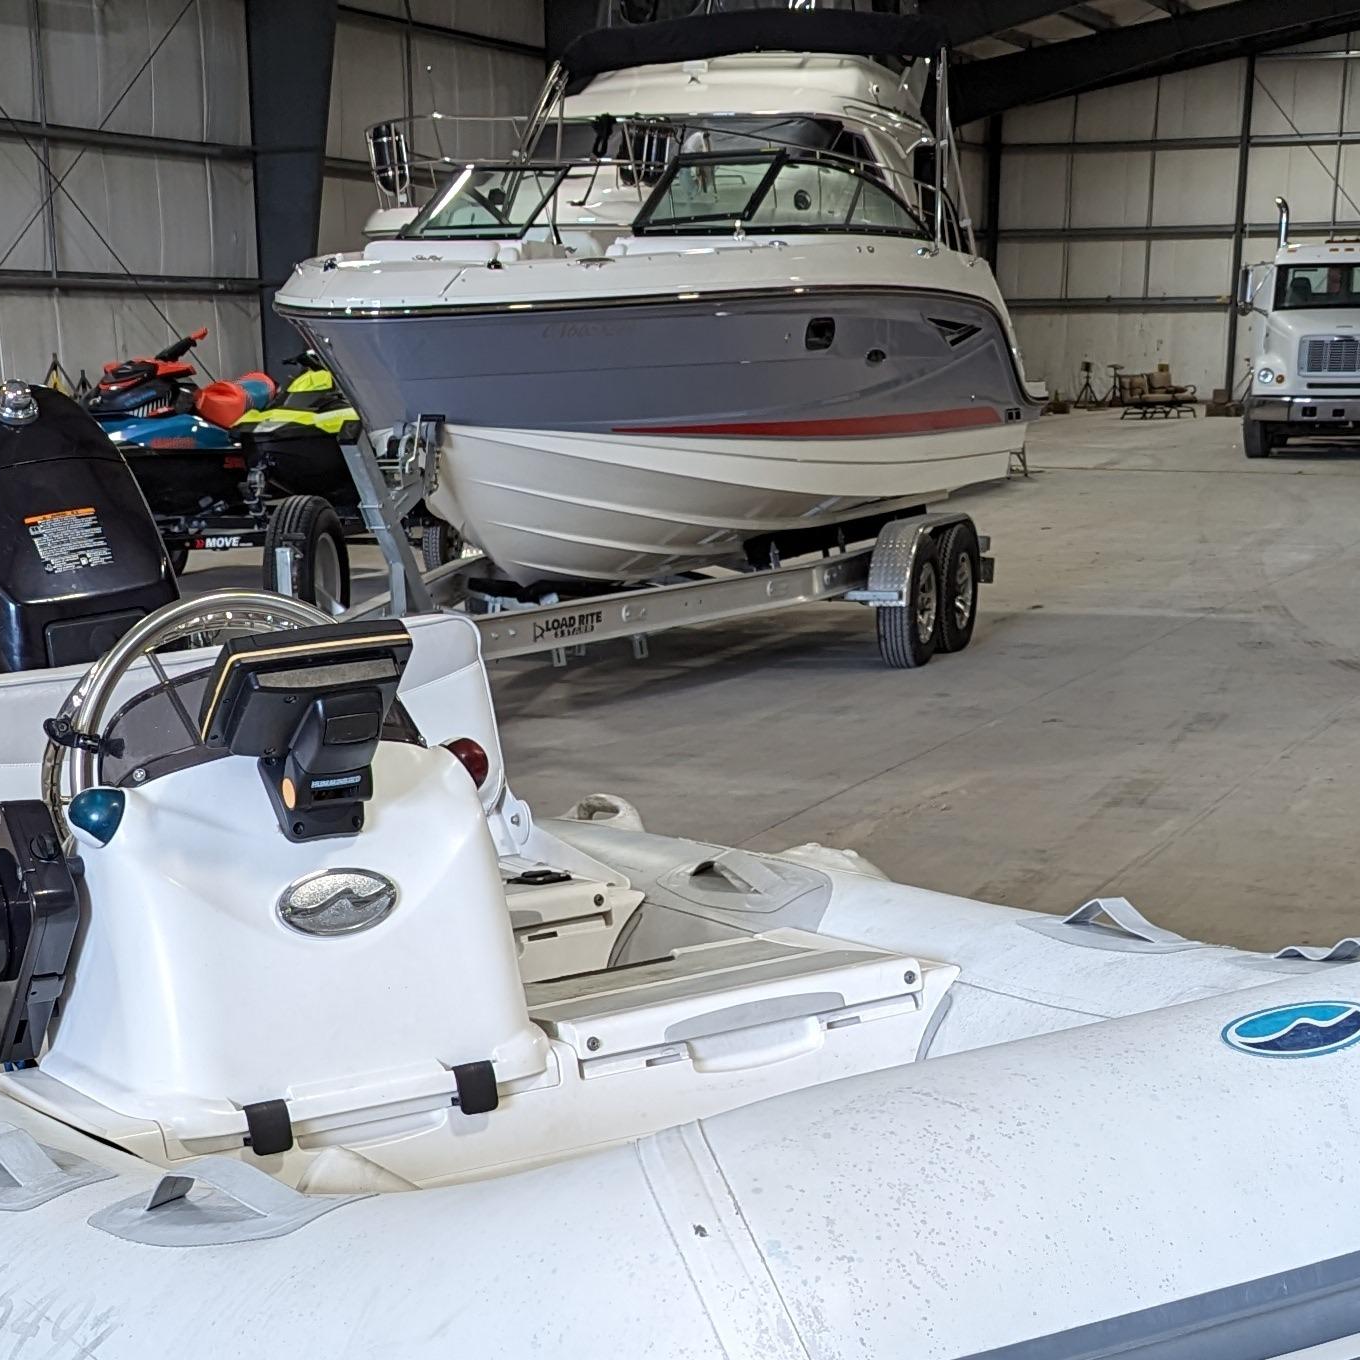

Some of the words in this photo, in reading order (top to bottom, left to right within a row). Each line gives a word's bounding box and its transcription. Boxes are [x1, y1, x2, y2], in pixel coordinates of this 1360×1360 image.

[205, 536, 242, 548] MOVE
[545, 616, 577, 632] LOAD
[578, 611, 603, 626] RITE
